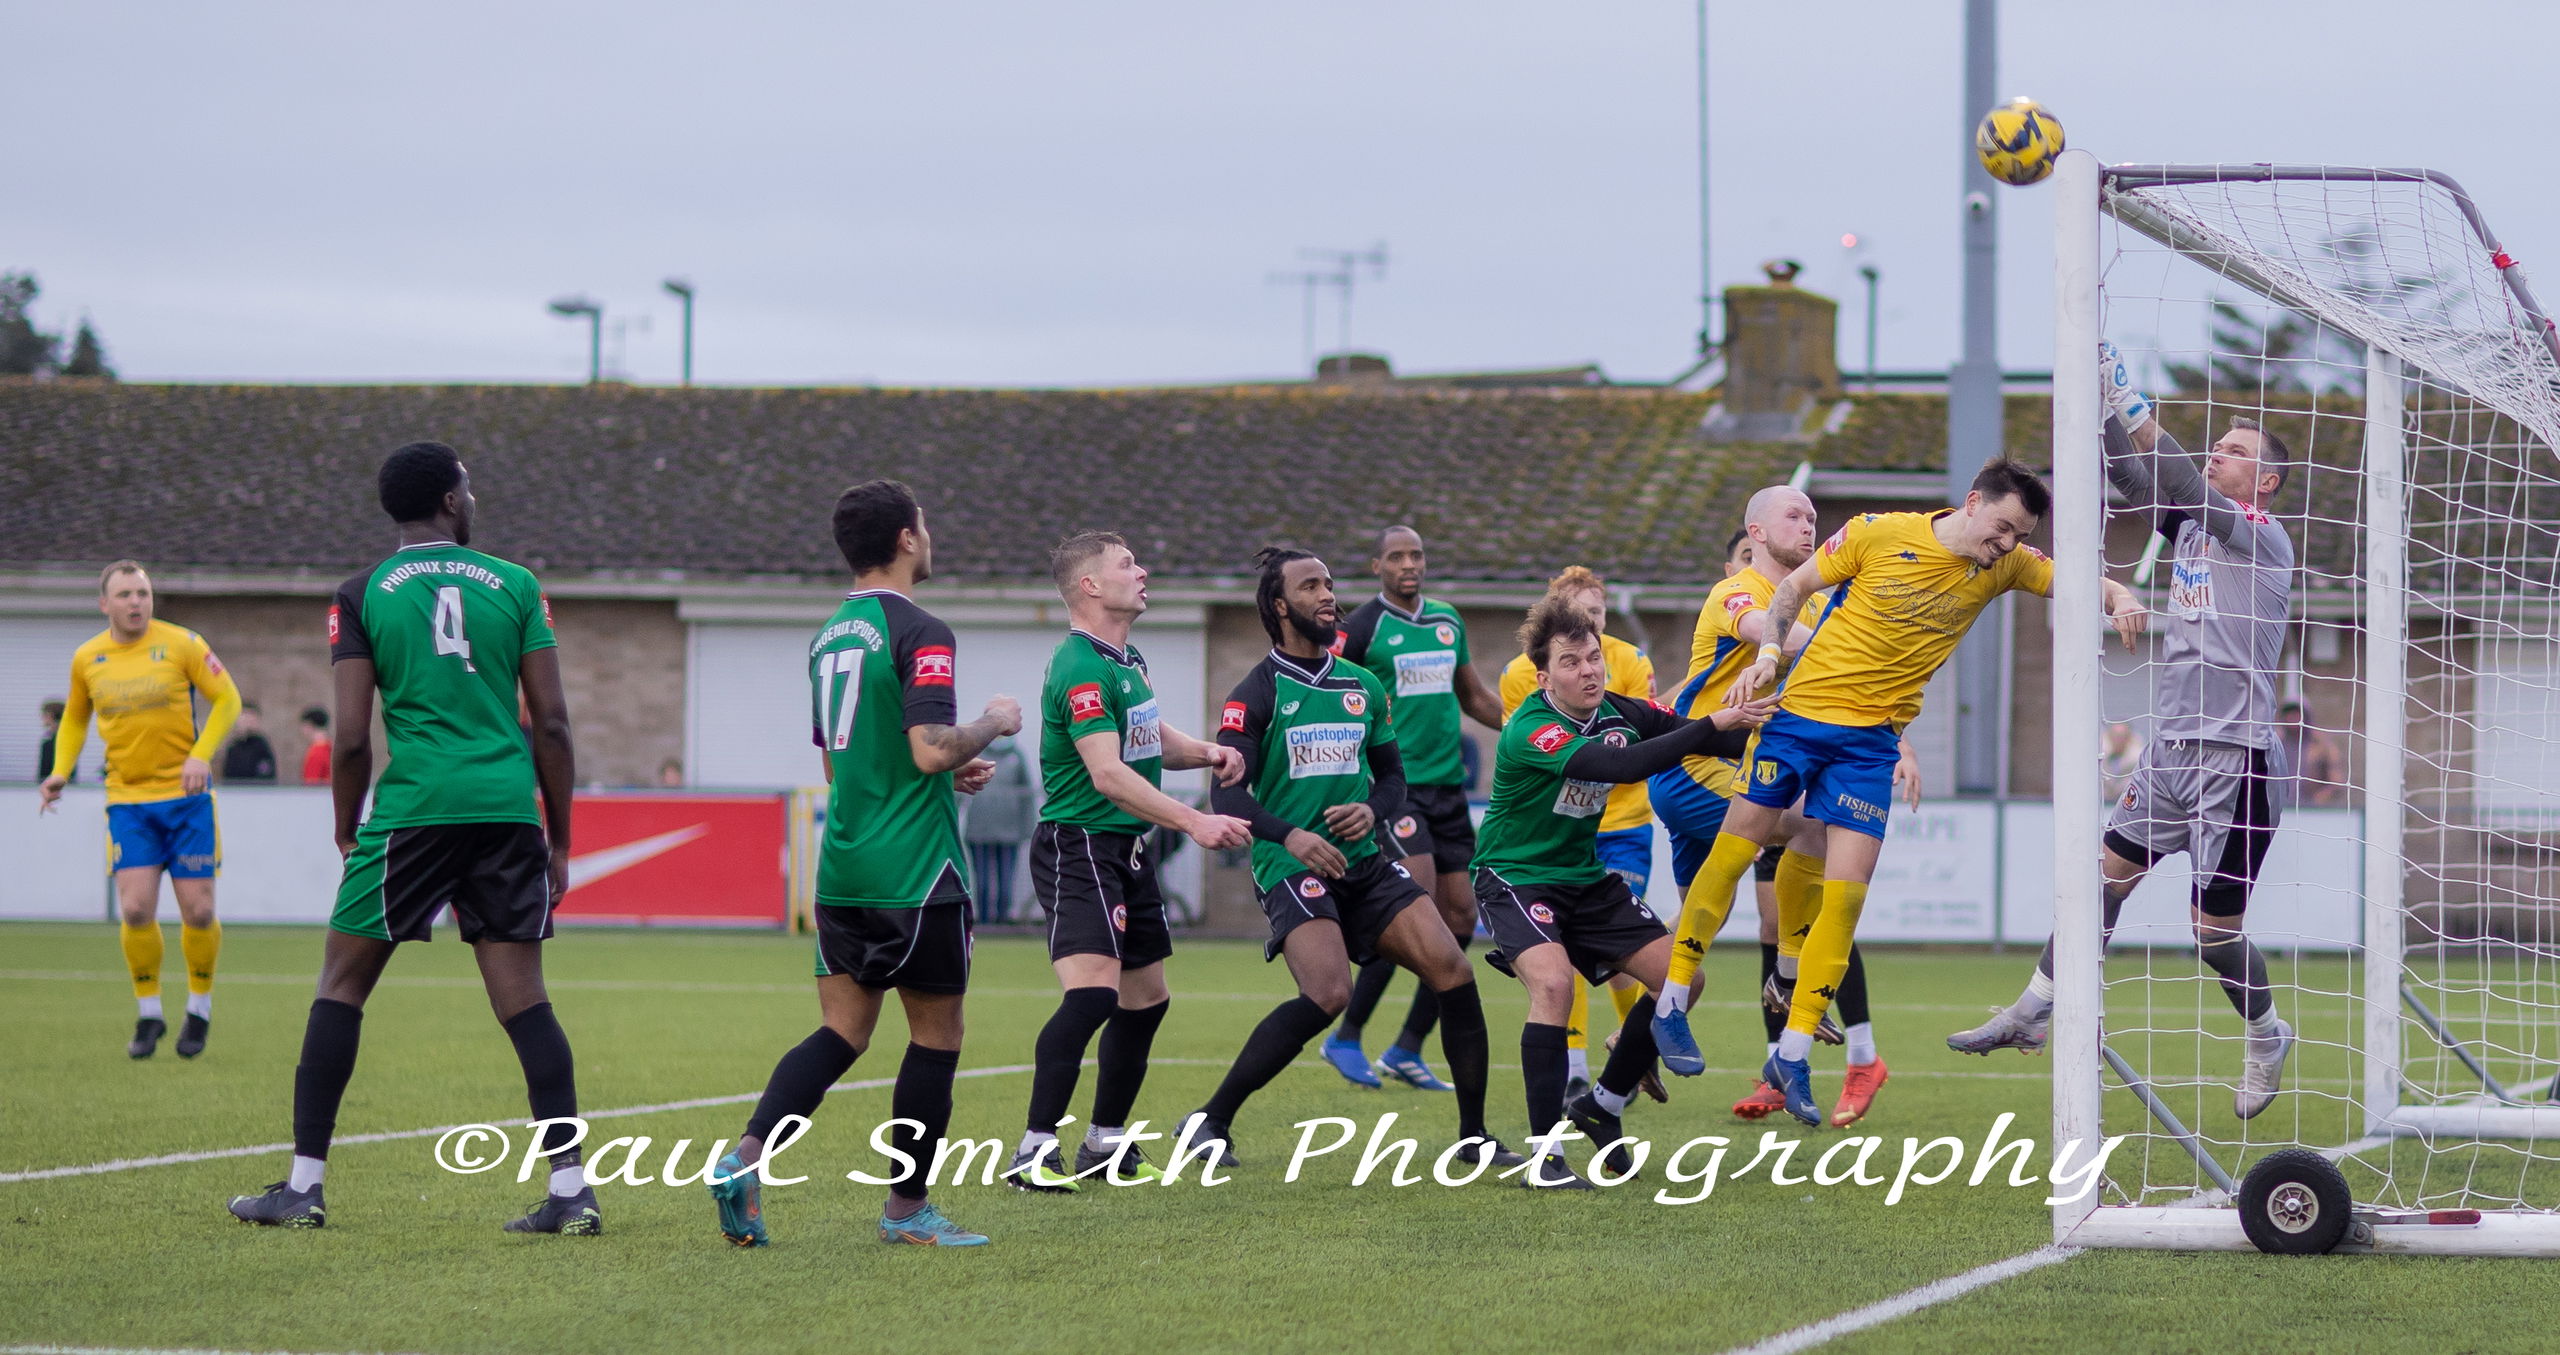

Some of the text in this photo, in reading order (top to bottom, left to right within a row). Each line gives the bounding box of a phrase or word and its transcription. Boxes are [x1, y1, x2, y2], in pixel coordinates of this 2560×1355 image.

[379, 561, 503, 593] PHOENIX SPORTS
[434, 586, 476, 673] 4
[851, 619, 883, 652] SPORTS
[819, 647, 865, 752] 17
[1290, 727, 1362, 745] Christopher
[1836, 793, 1887, 824] FISHERS
[1853, 810, 1870, 823] GIN
